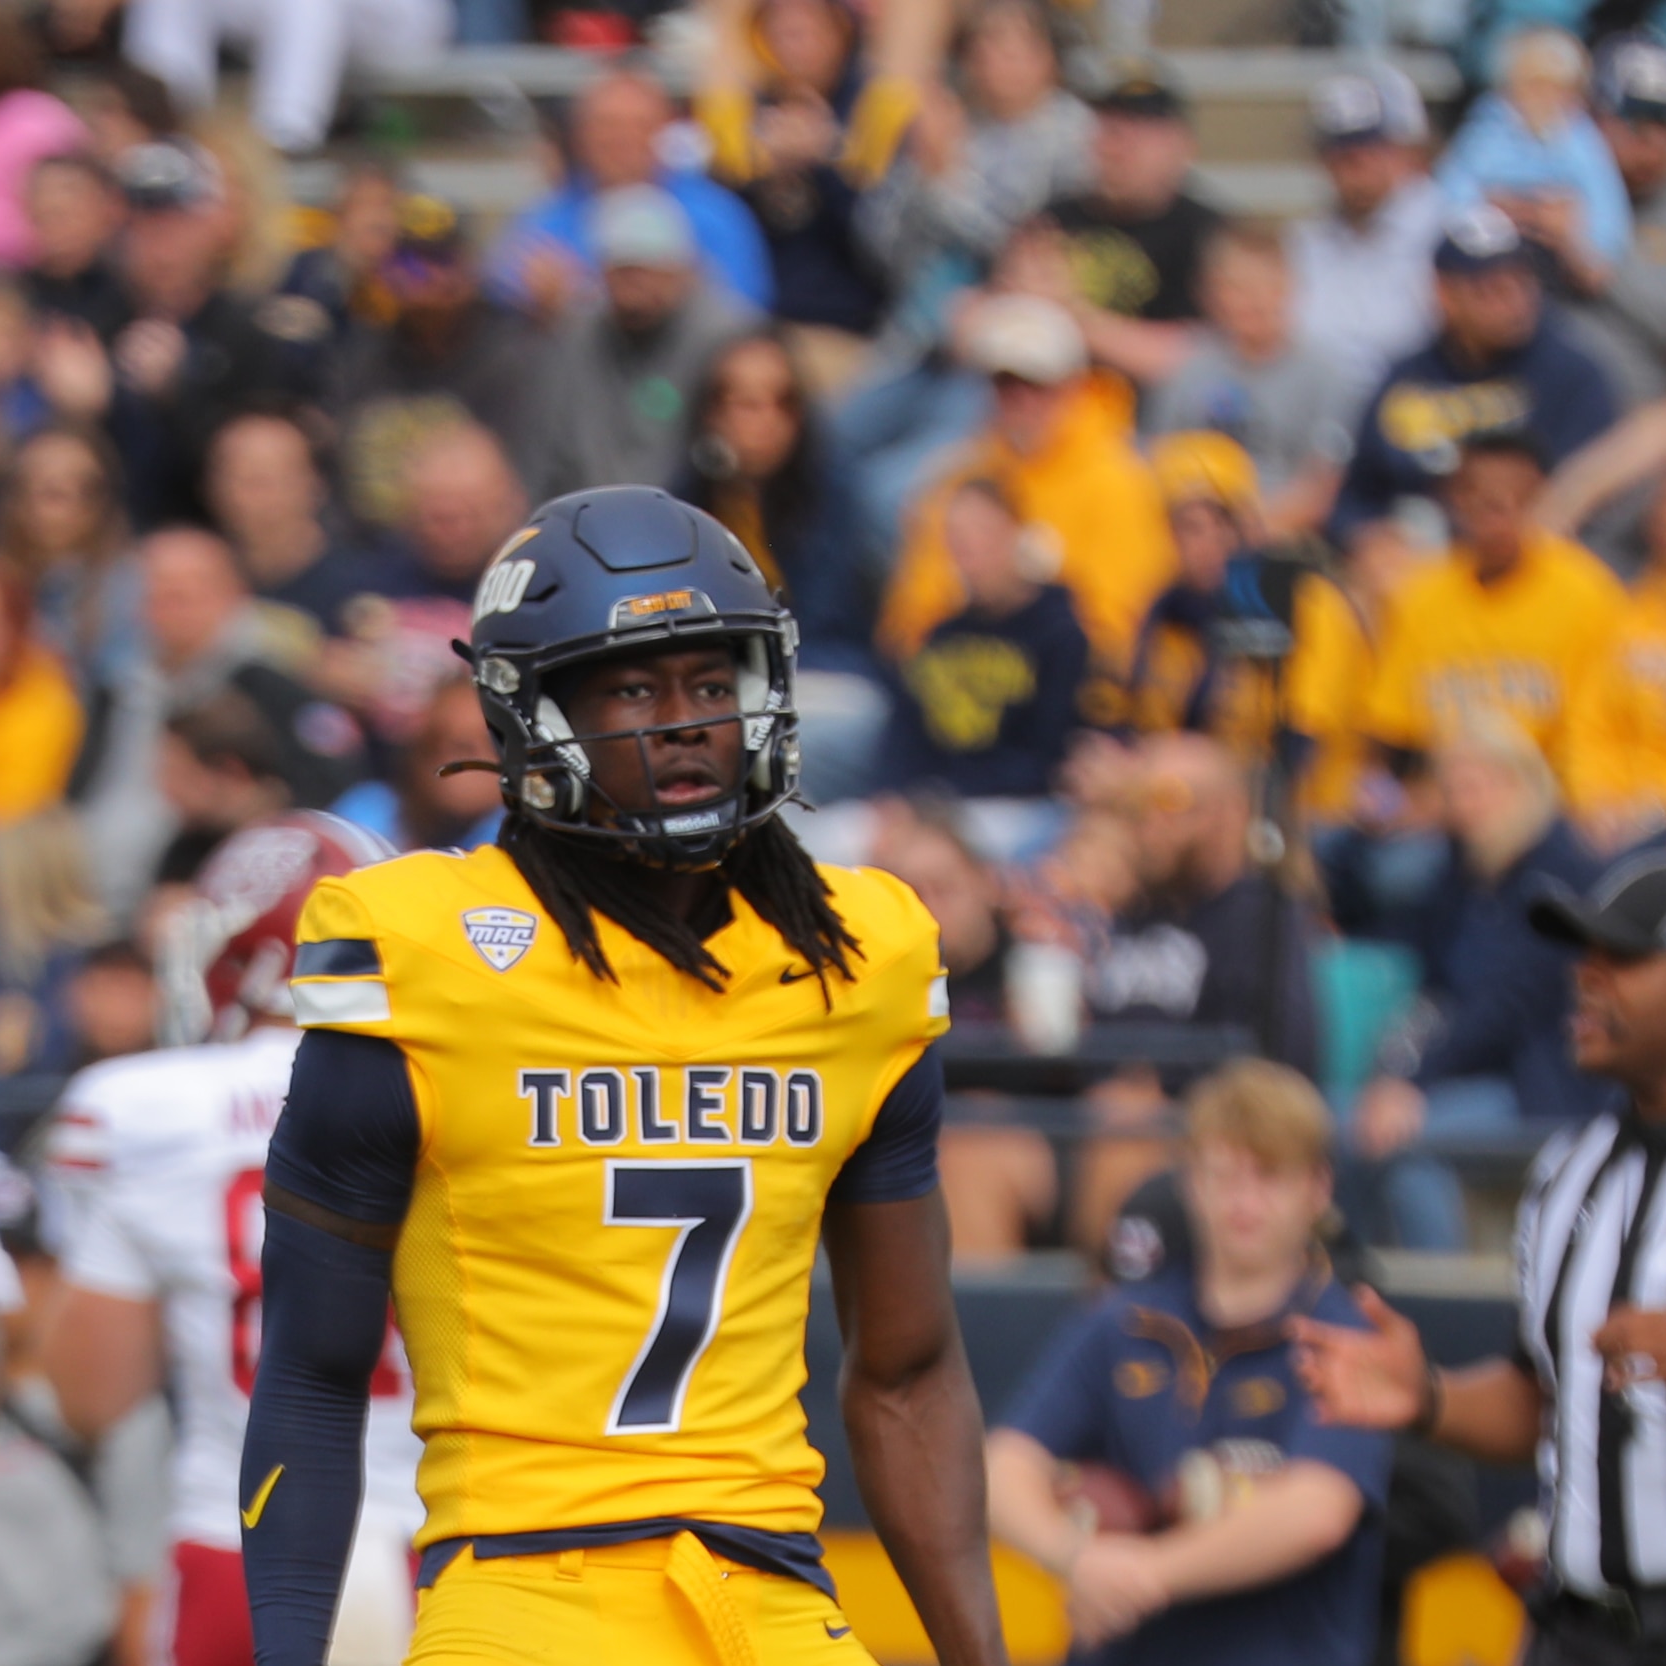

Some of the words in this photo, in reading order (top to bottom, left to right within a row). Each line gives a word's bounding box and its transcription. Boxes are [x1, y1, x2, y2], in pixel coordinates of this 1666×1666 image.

[466, 924, 536, 946] MAC
[518, 1065, 823, 1149] TOLEDO
[603, 1157, 753, 1436] 7
